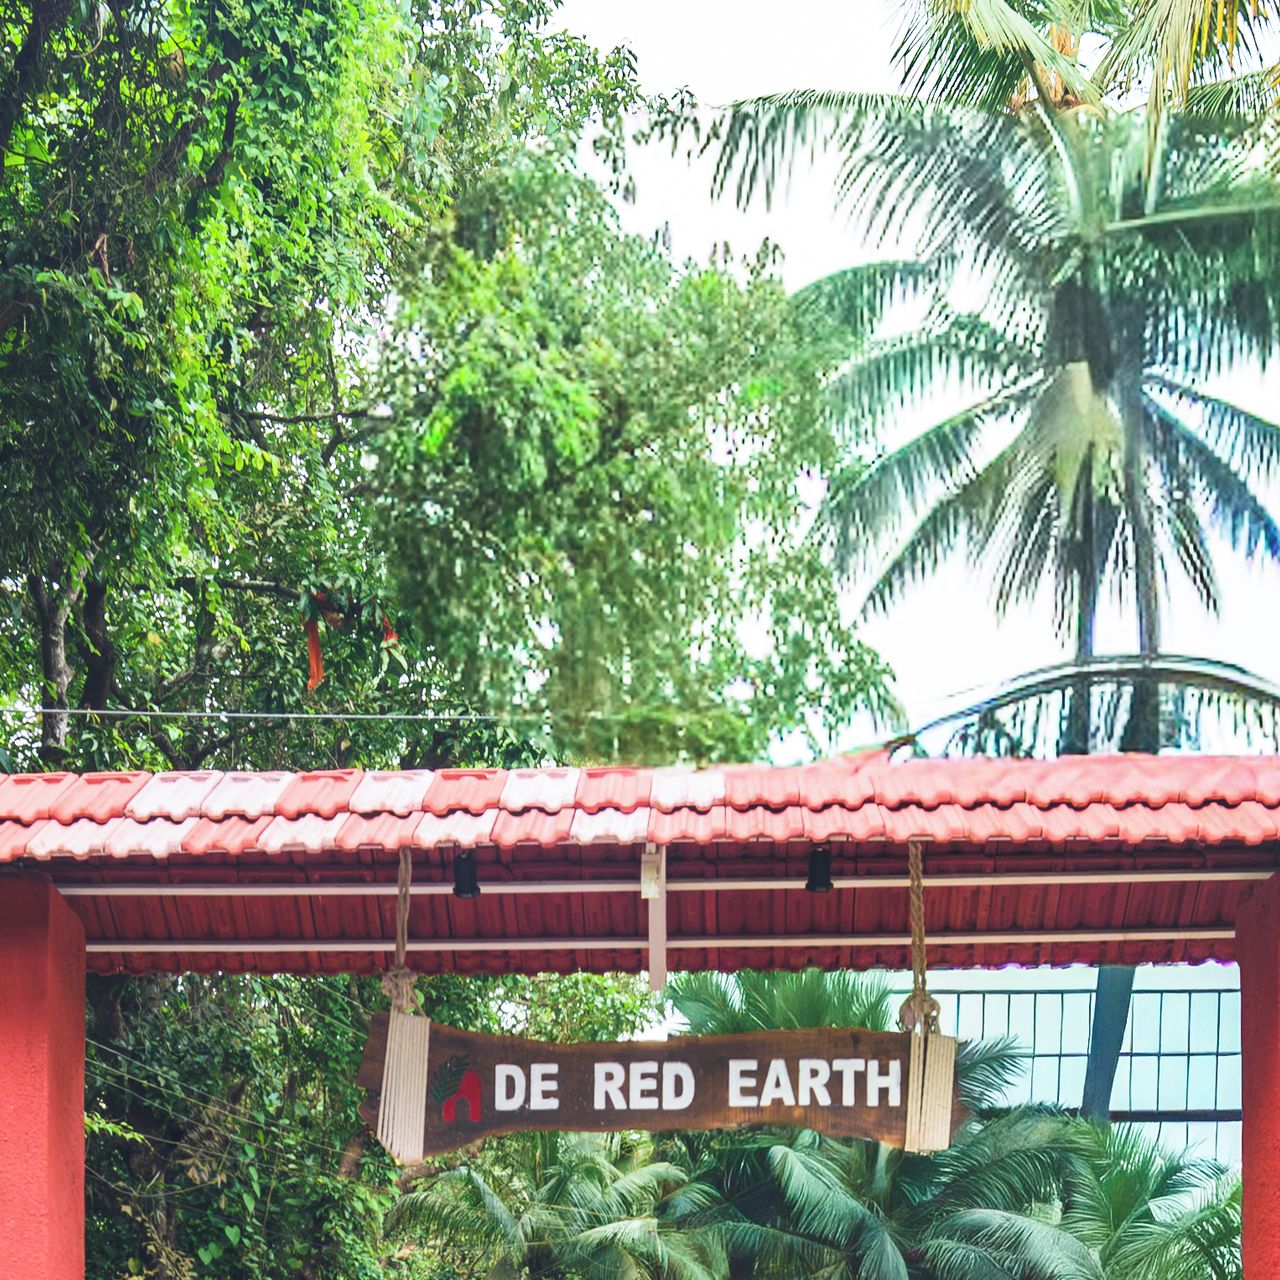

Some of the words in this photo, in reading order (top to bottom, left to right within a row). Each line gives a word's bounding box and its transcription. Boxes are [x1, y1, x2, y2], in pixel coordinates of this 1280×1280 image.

[494, 1062, 559, 1111] DE
[593, 1061, 696, 1111] RED
[728, 1058, 902, 1107] EARTH
